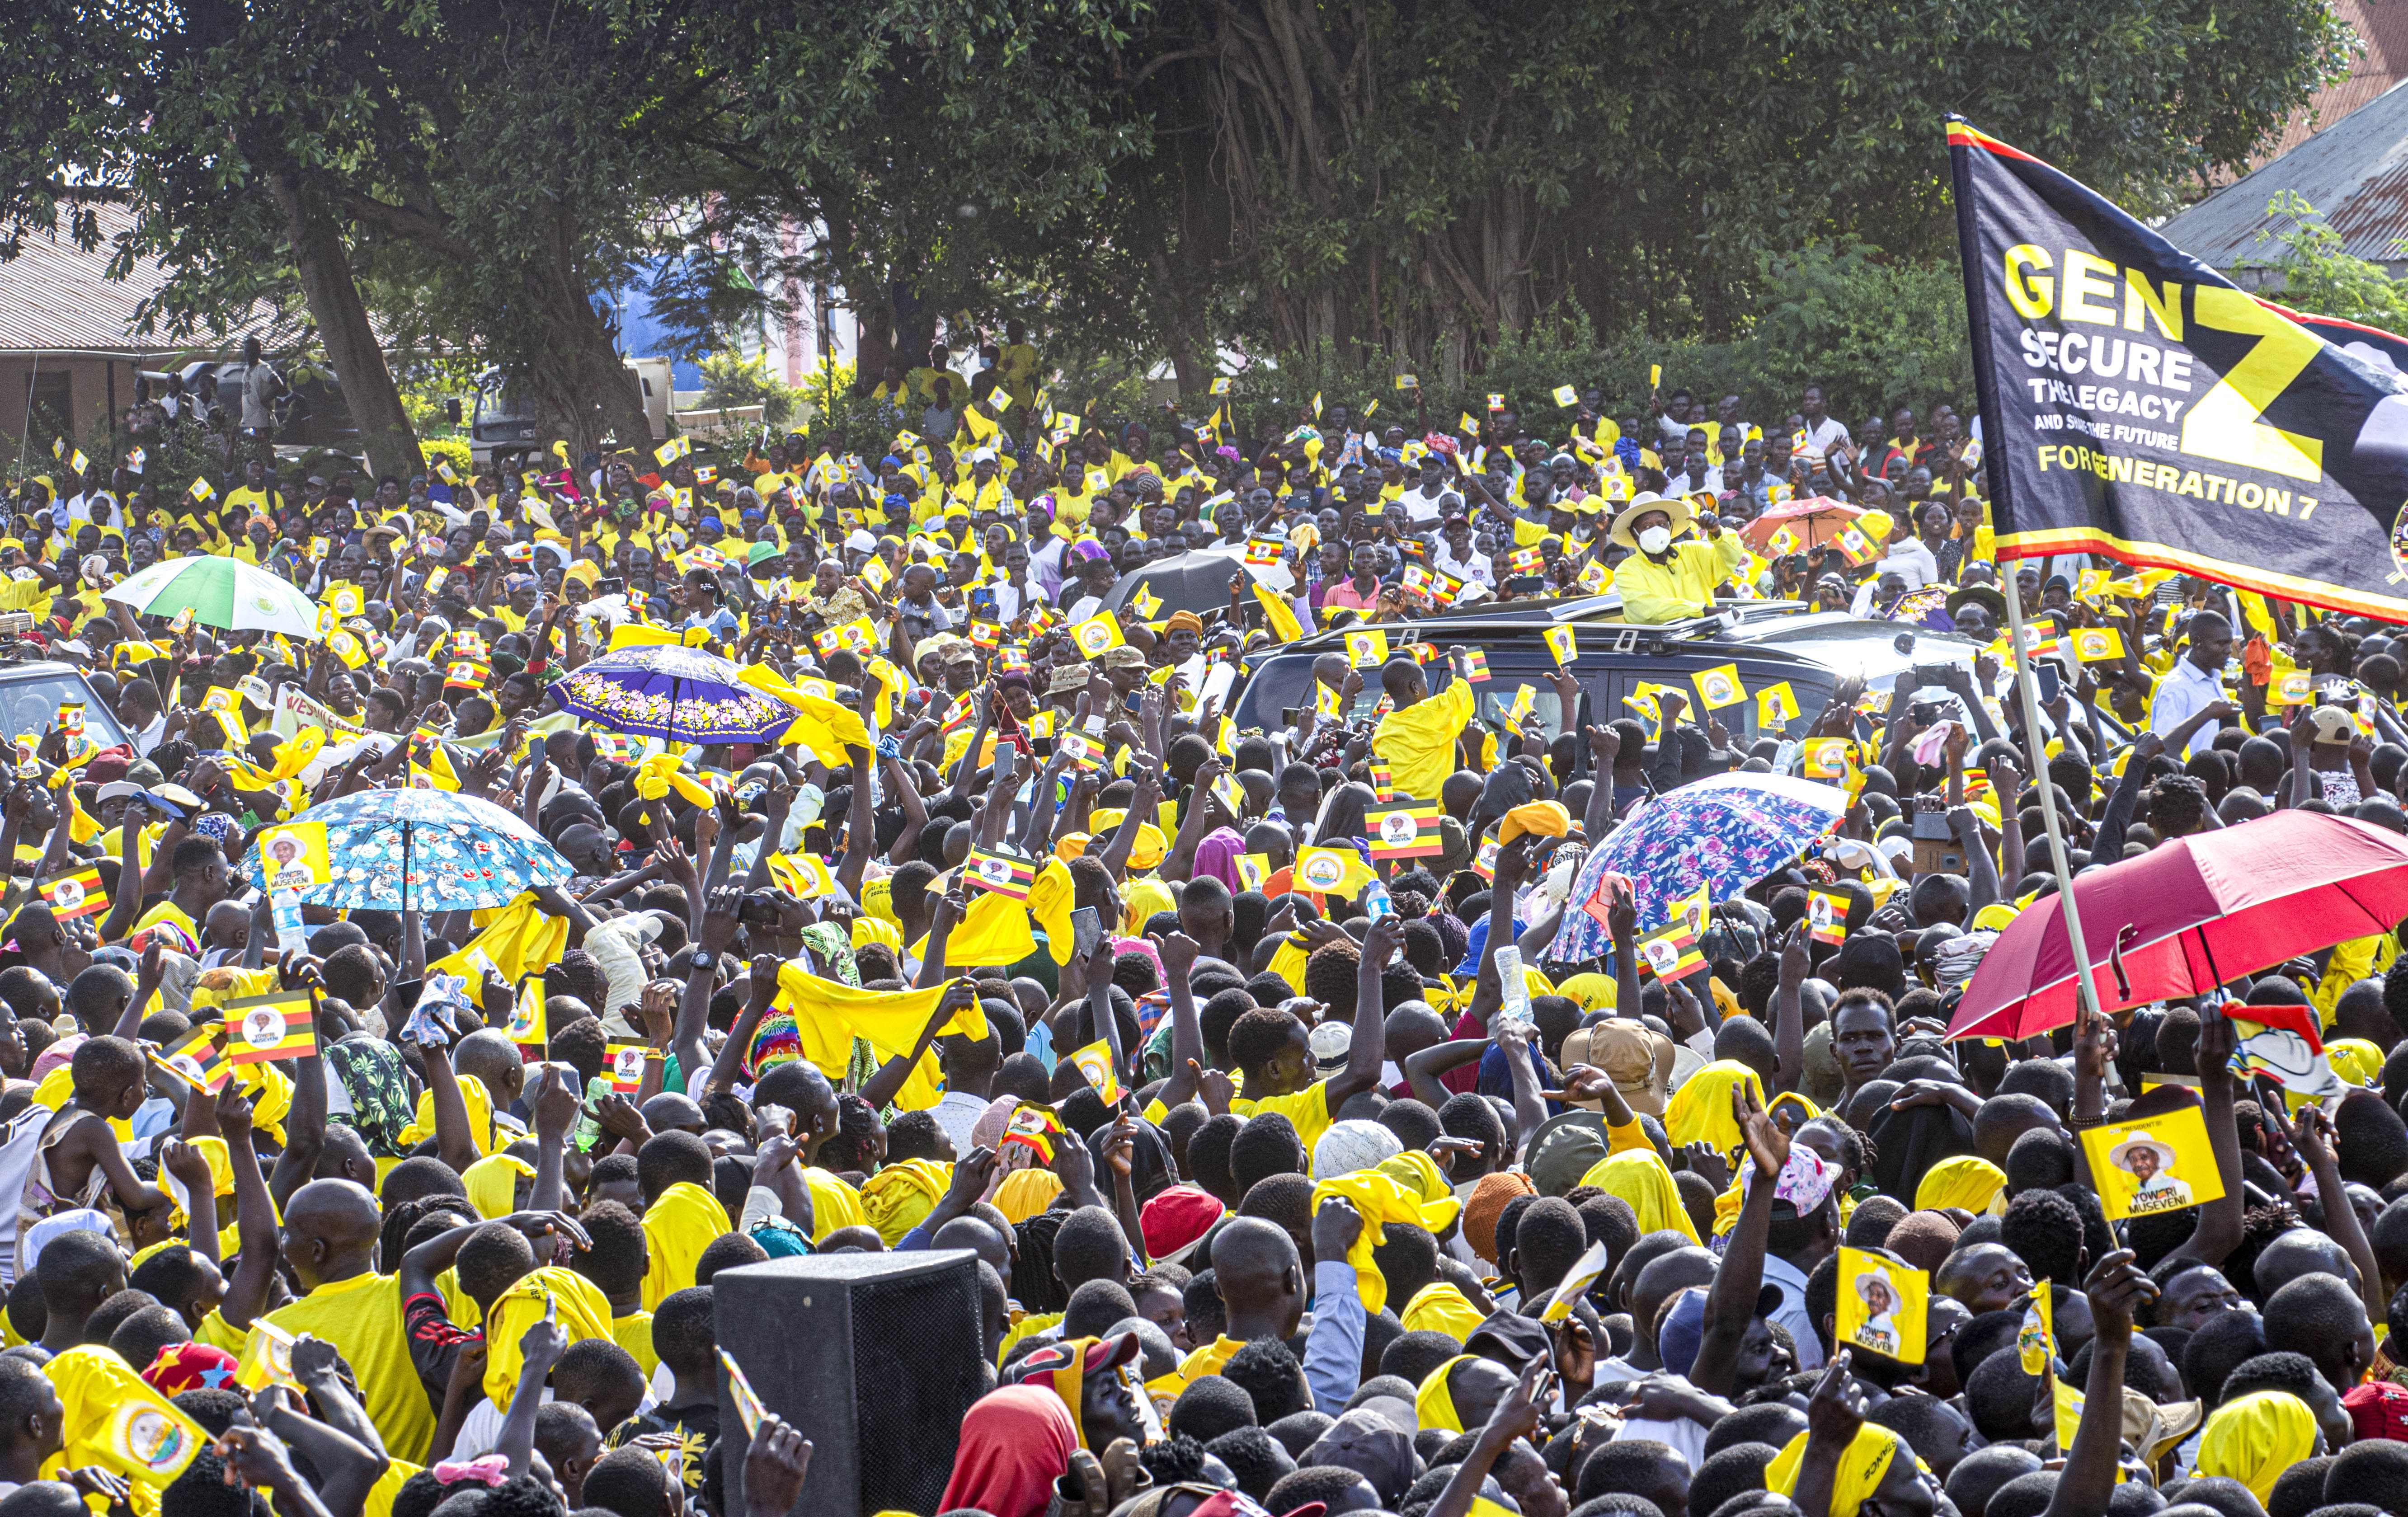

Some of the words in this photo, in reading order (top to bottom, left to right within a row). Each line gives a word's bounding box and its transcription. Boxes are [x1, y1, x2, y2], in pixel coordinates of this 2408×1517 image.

[2005, 244, 2183, 342] GEN
[2181, 284, 2325, 483] Z
[2020, 328, 2193, 392] SECURE
[2027, 378, 2071, 404] THE
[2067, 385, 2184, 423] LEGACY
[2034, 414, 2063, 430] AND
[2086, 422, 2111, 439] THE
[2113, 425, 2178, 451] FUTURE
[2038, 445, 2092, 471] FOR
[2091, 451, 2291, 516] GENERATION
[2298, 495, 2318, 520] 7
[271, 877, 308, 888] MUSEVENI
[273, 870, 304, 880] YOWERI
[1656, 958, 1671, 967] YOWERI
[1656, 961, 1675, 971] MUSEVENI
[2131, 1186, 2178, 1203] YOWERI
[2128, 1195, 2187, 1214] MUSEVENI
[1861, 1323, 1891, 1342] YOWER
